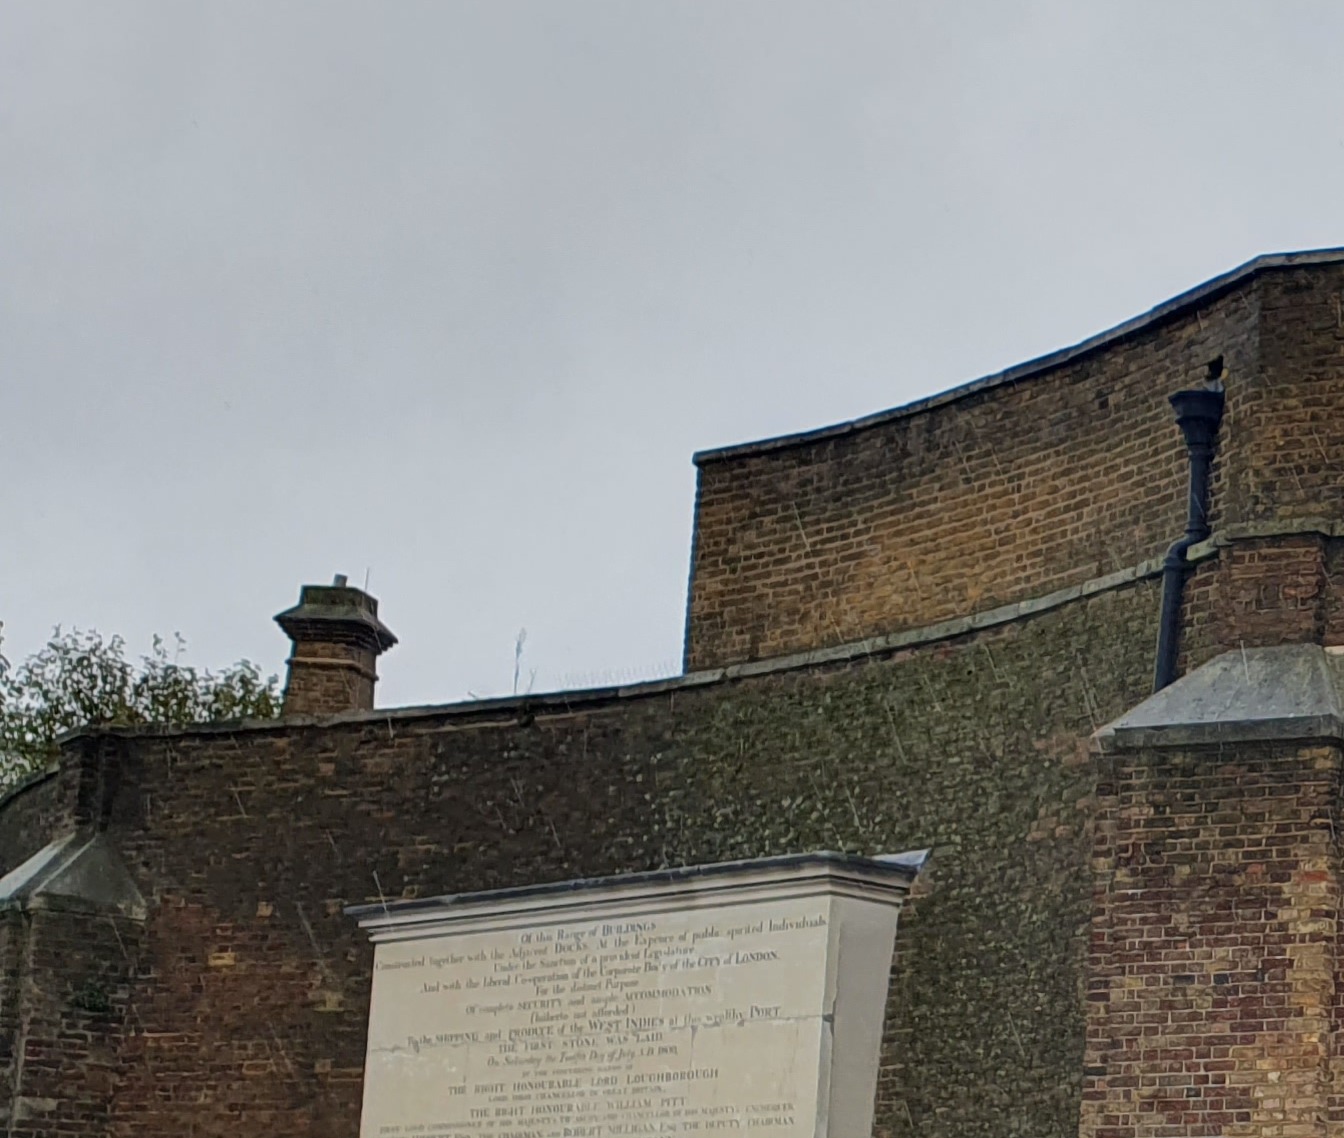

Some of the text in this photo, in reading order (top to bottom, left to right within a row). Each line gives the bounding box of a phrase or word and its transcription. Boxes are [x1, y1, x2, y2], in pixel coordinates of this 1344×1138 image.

[490, 947, 504, 959] the
[614, 934, 629, 947] the
[522, 959, 535, 969] the
[466, 977, 479, 989] the
[583, 965, 596, 977] the
[682, 956, 696, 968] the
[552, 983, 565, 993] the
[749, 1002, 781, 1018] PORT
[626, 1068, 718, 1083] LOUGHBOROUGH
